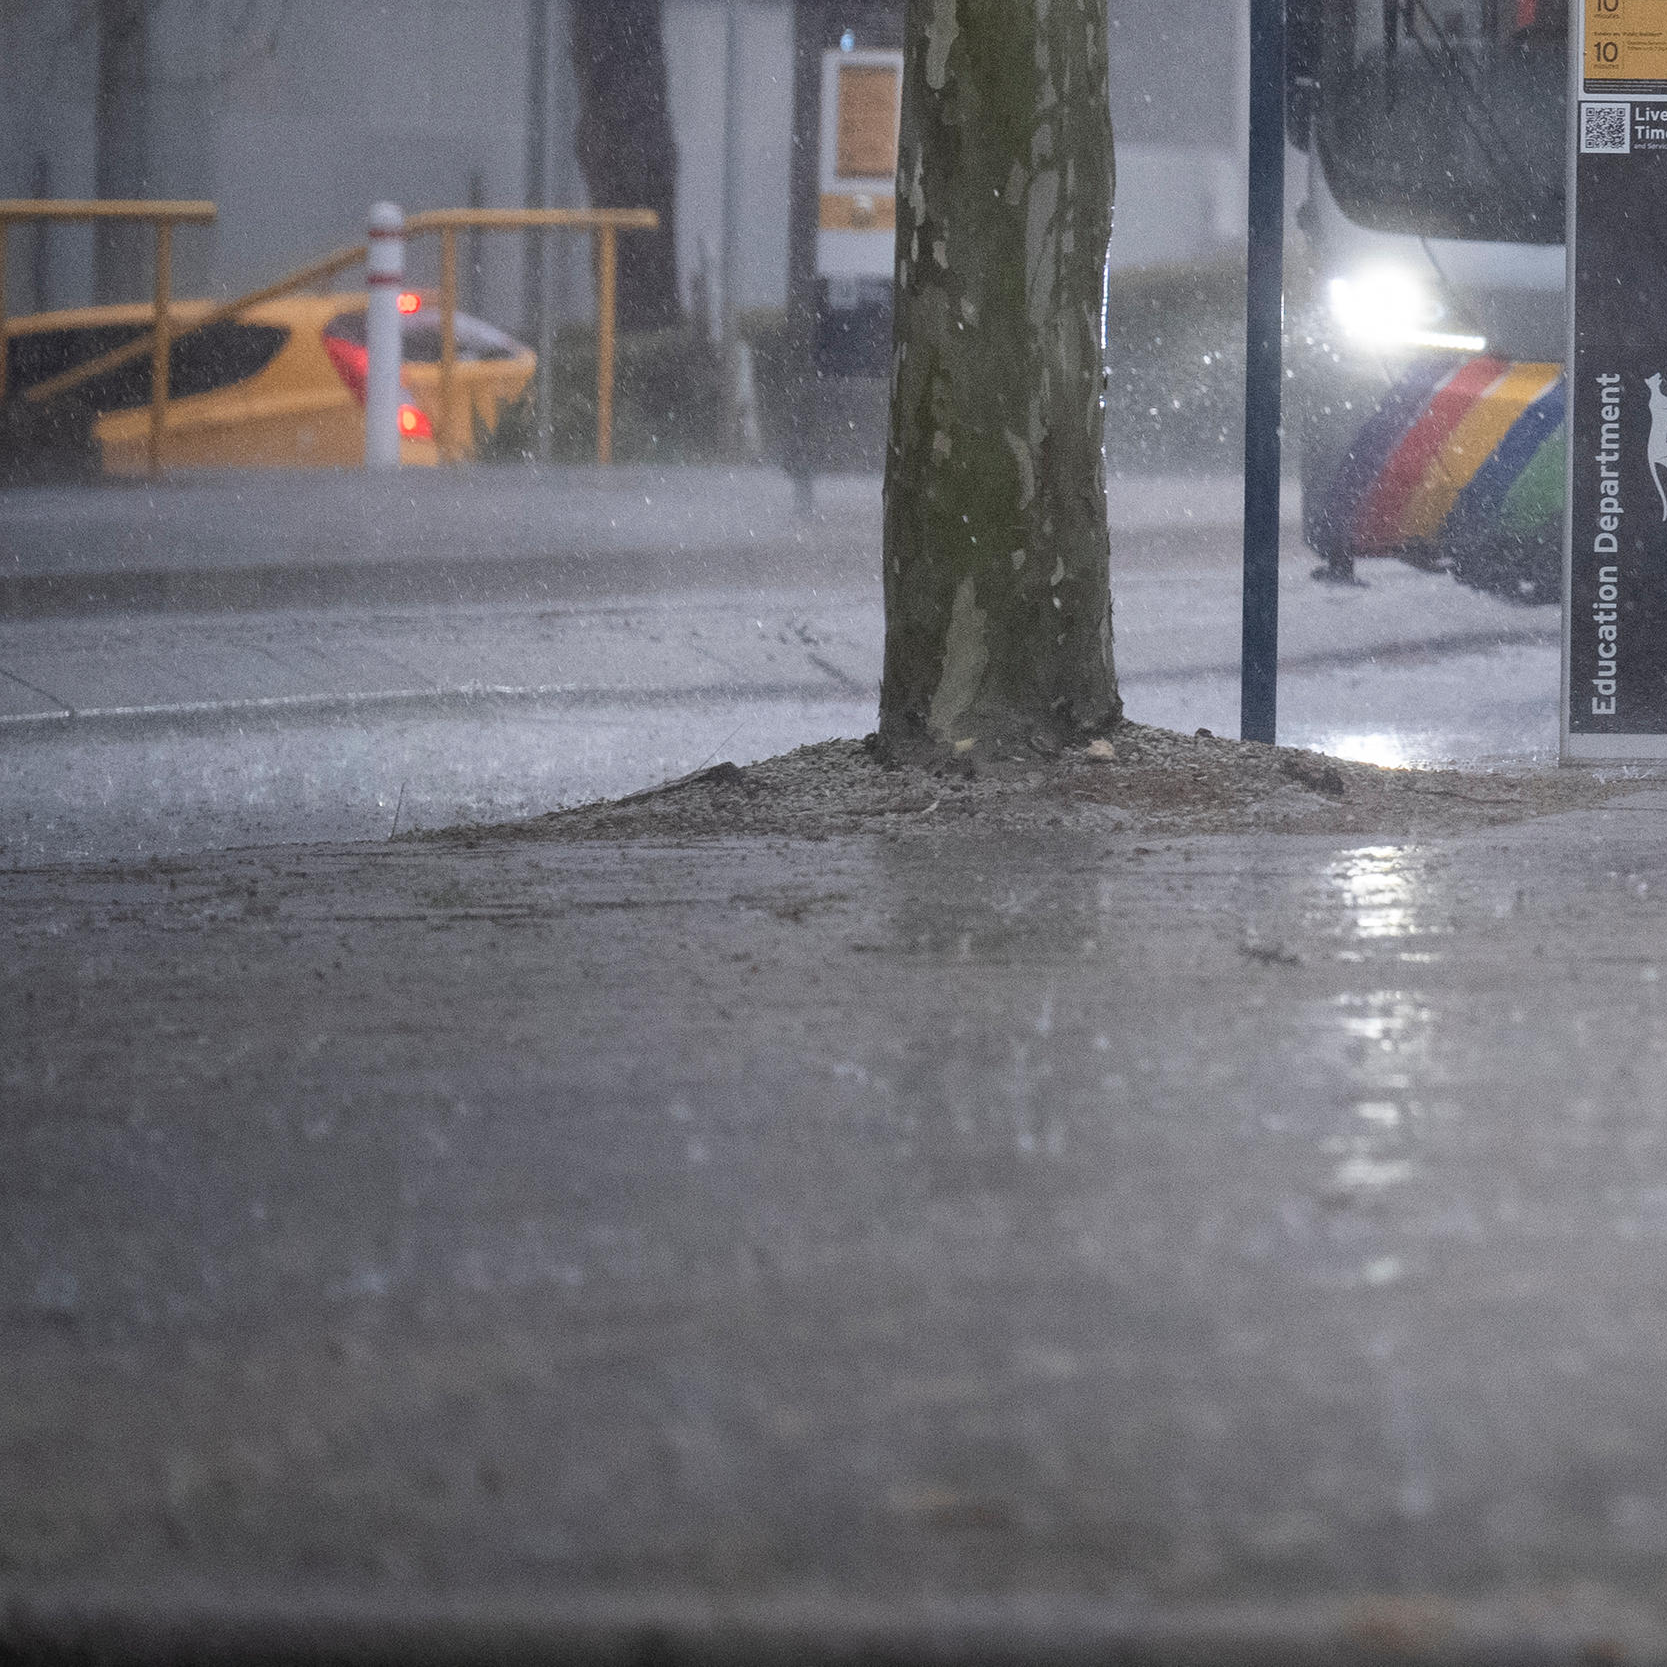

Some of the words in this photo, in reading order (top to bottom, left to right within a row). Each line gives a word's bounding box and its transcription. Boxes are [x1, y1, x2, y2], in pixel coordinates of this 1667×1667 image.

[1594, 41, 1618, 62] 10
[1594, 373, 1623, 553] Department
[1591, 565, 1618, 715] Education
